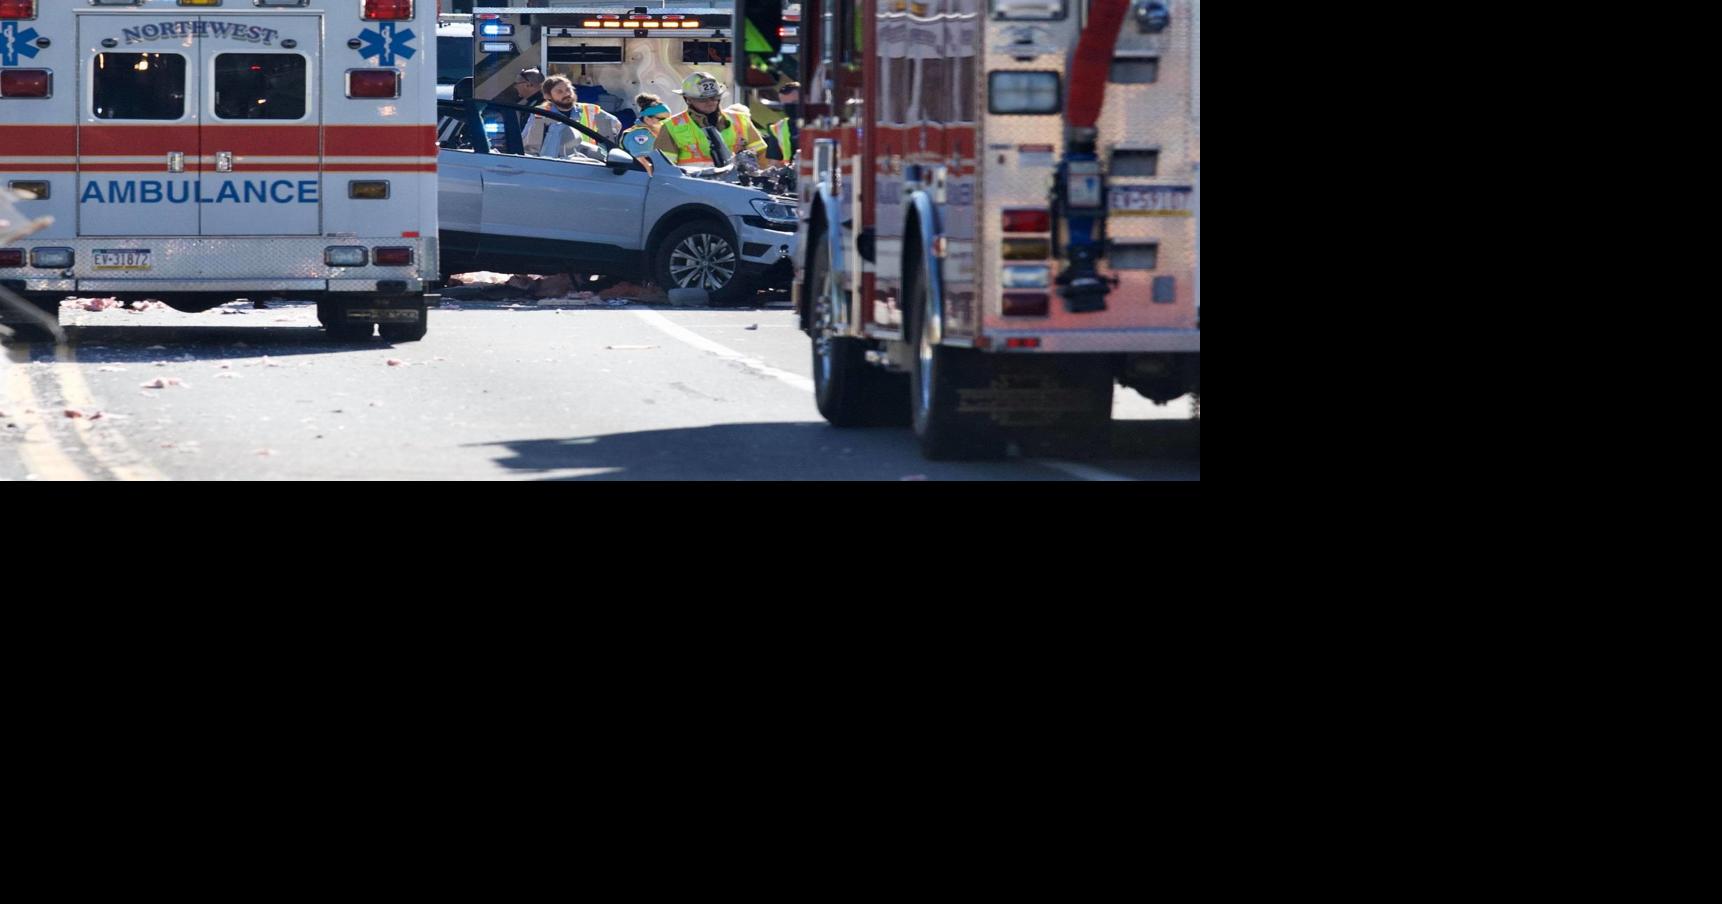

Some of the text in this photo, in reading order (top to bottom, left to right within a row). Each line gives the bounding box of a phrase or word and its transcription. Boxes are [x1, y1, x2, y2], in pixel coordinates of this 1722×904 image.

[122, 21, 278, 45] NORTHWEST
[702, 82, 715, 91] 22
[80, 180, 319, 204] AMBULANCE
